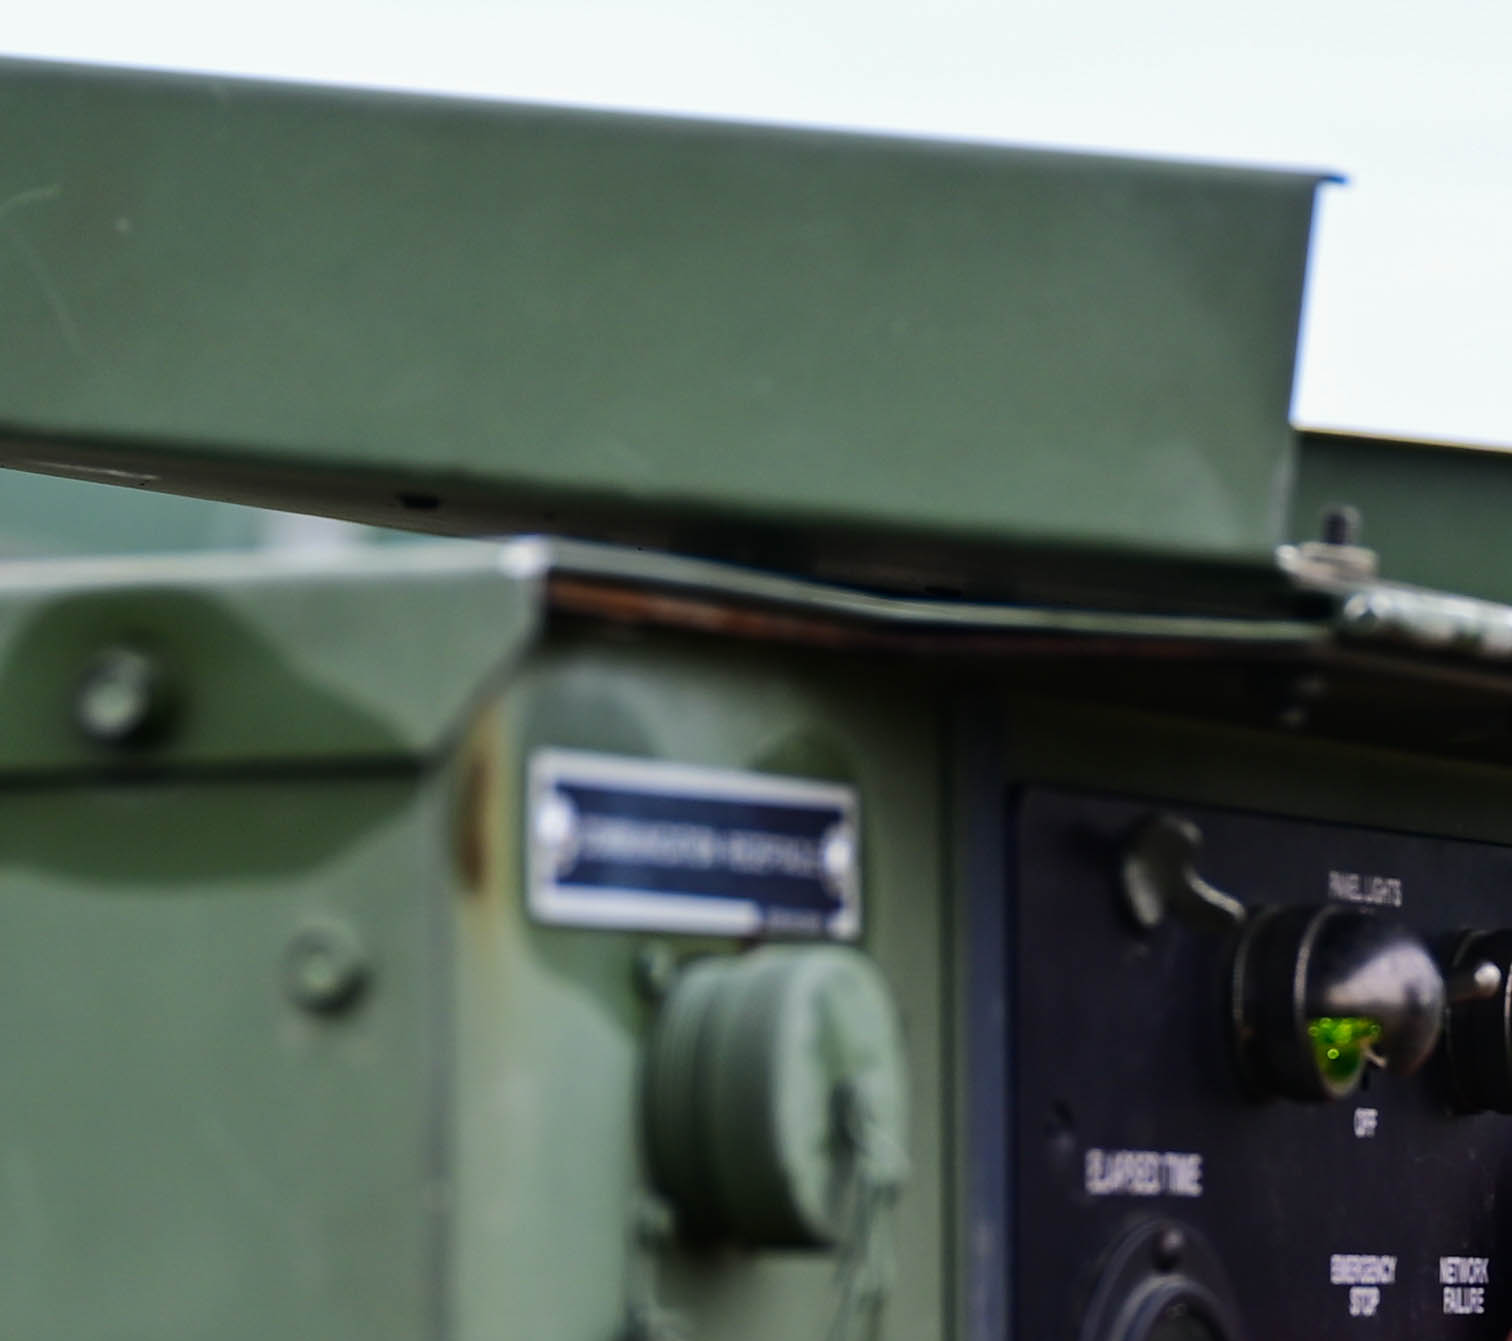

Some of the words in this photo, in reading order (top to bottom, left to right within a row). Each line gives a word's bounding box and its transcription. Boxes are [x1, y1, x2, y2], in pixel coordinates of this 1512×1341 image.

[1353, 1107, 1378, 1139] OFF
[1439, 1255, 1489, 1285] NETWORK
[1349, 1286, 1381, 1317] STOP
